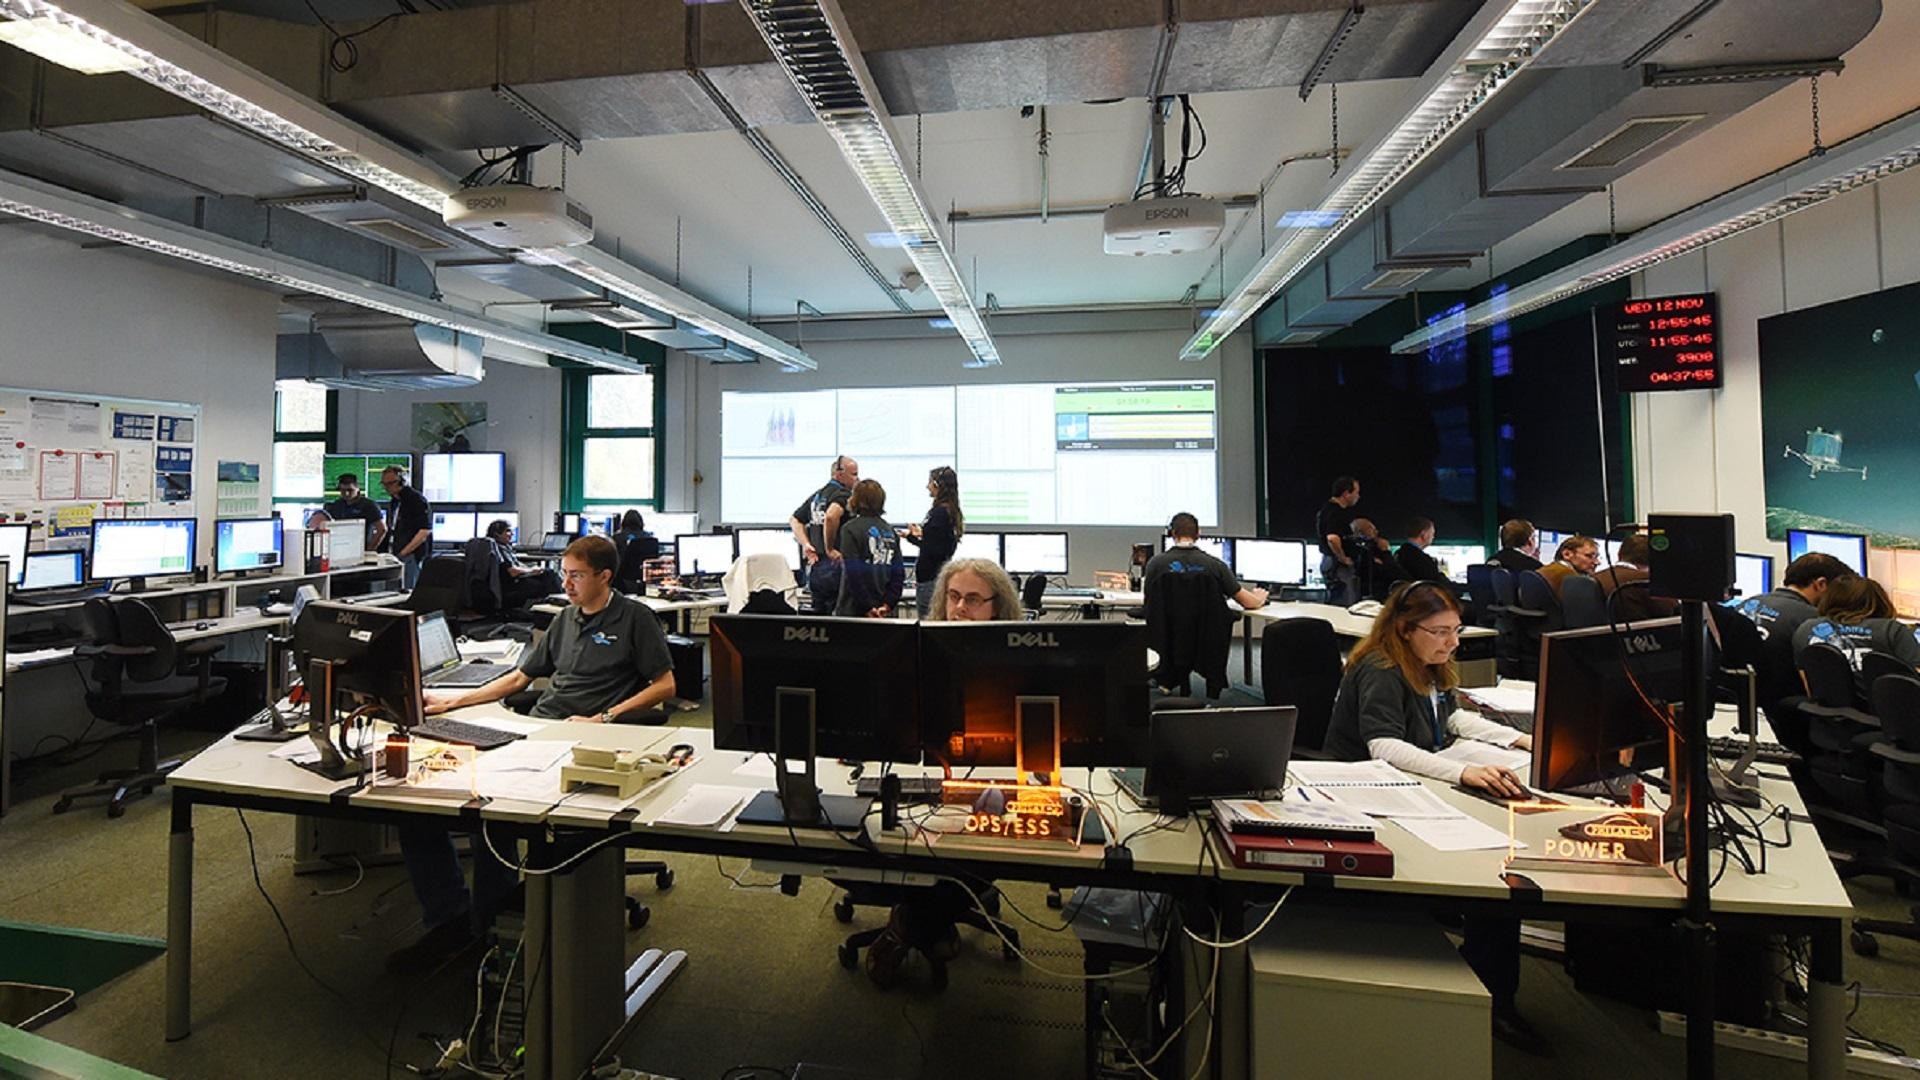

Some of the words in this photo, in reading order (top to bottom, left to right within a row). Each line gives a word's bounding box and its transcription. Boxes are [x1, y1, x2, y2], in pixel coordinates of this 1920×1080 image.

[466, 196, 507, 210] EPSON
[1145, 207, 1189, 221] EPSON
[1624, 302, 1653, 315] WED
[1656, 301, 1673, 312] 12
[1649, 315, 1712, 330] 12:55:45
[1650, 333, 1713, 347] 11:55:45
[1676, 351, 1713, 364] 3908
[1650, 369, 1714, 383] 04:37:55
[335, 611, 359, 625] DELL
[783, 626, 830, 643] DELL
[1007, 631, 1060, 647] DELL
[964, 814, 1051, 836] OPS/ESS
[1544, 838, 1627, 860] POWER
